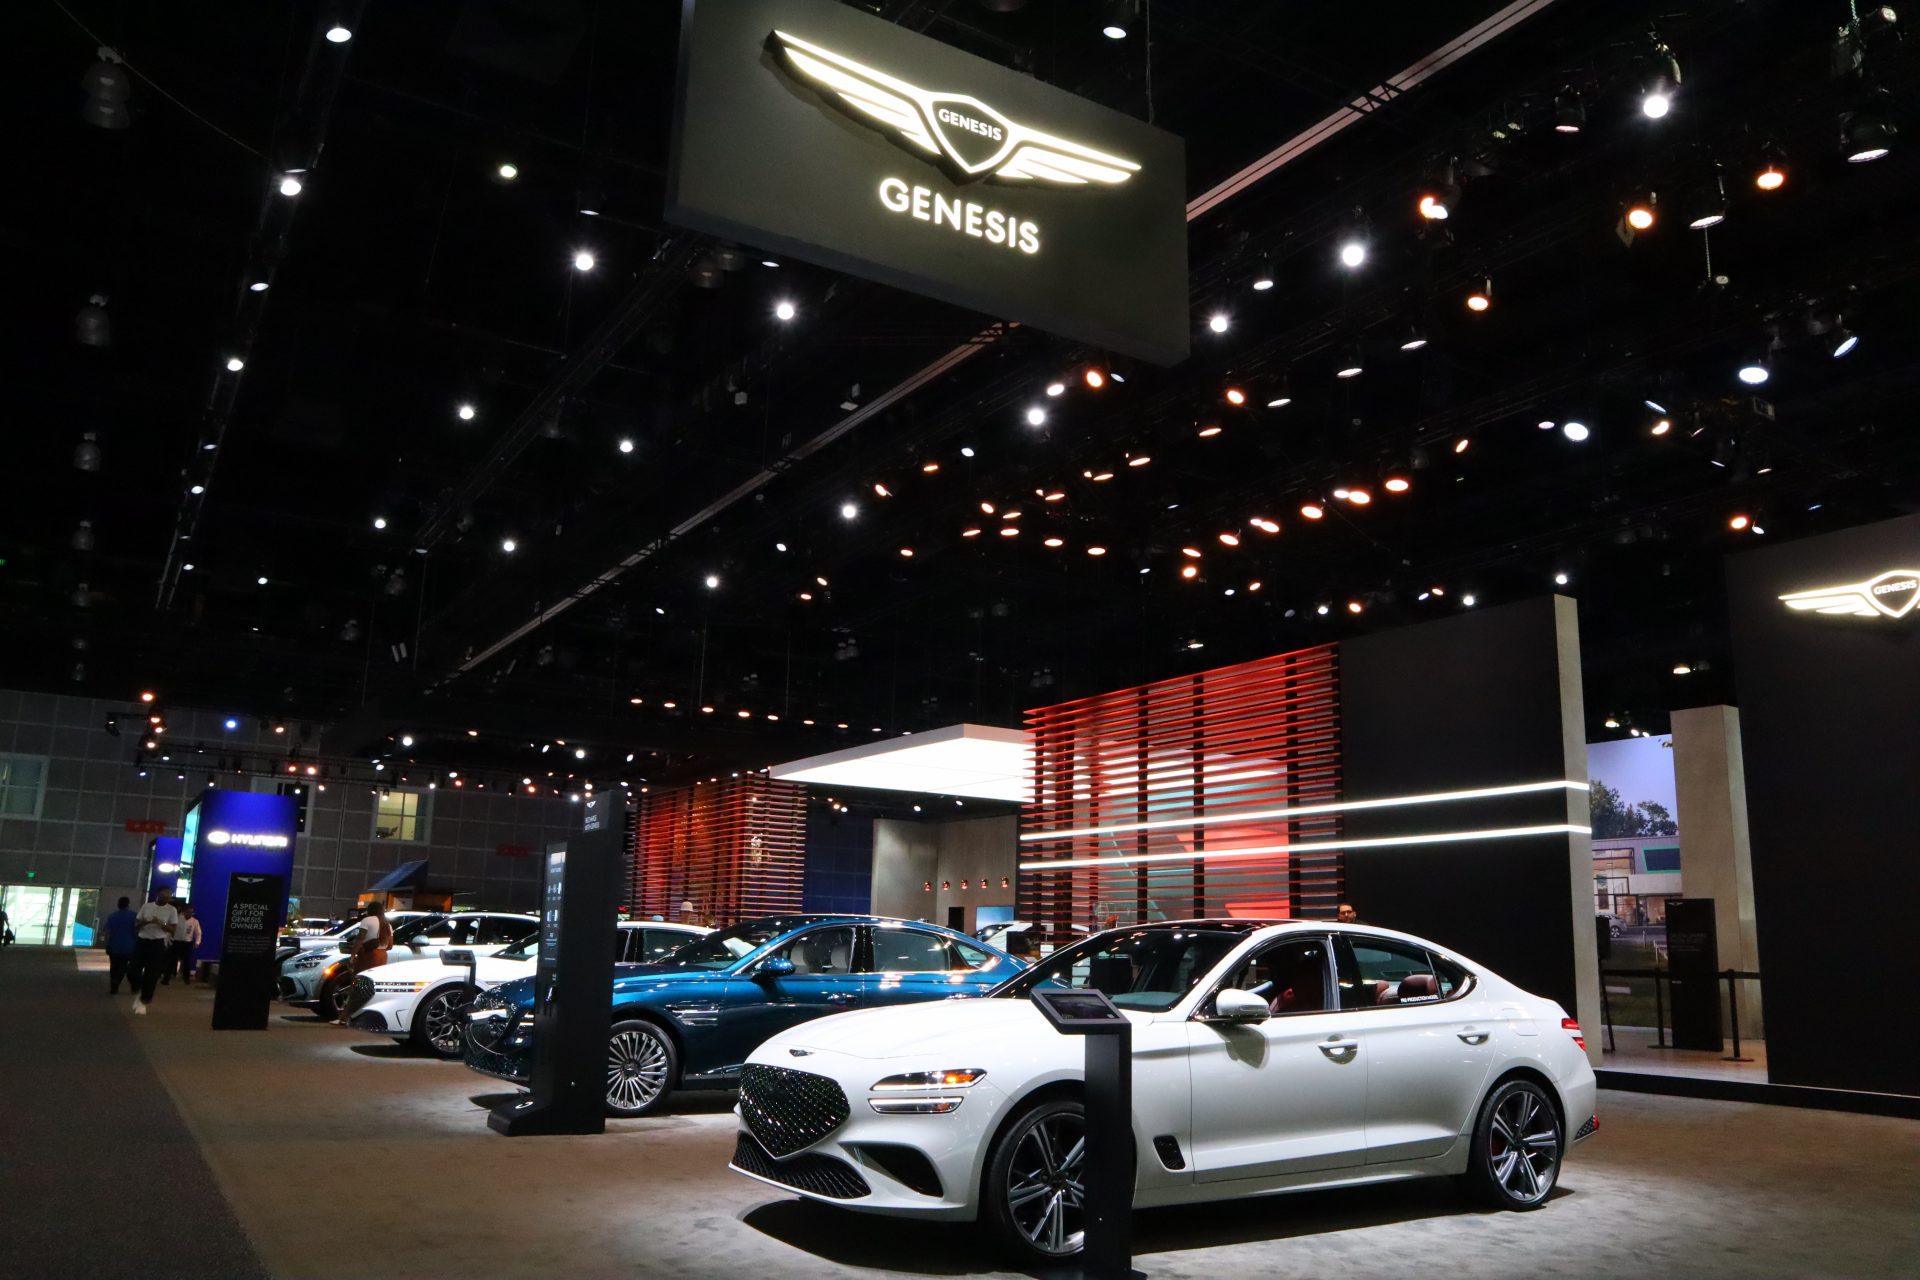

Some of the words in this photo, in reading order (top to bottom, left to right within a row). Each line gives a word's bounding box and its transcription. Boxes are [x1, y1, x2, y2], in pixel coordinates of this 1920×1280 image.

[938, 108, 1002, 141] GENESIS
[879, 177, 1040, 254] GENESIS
[1874, 580, 1917, 595] GENESIS
[240, 903, 269, 911] SPECIAL
